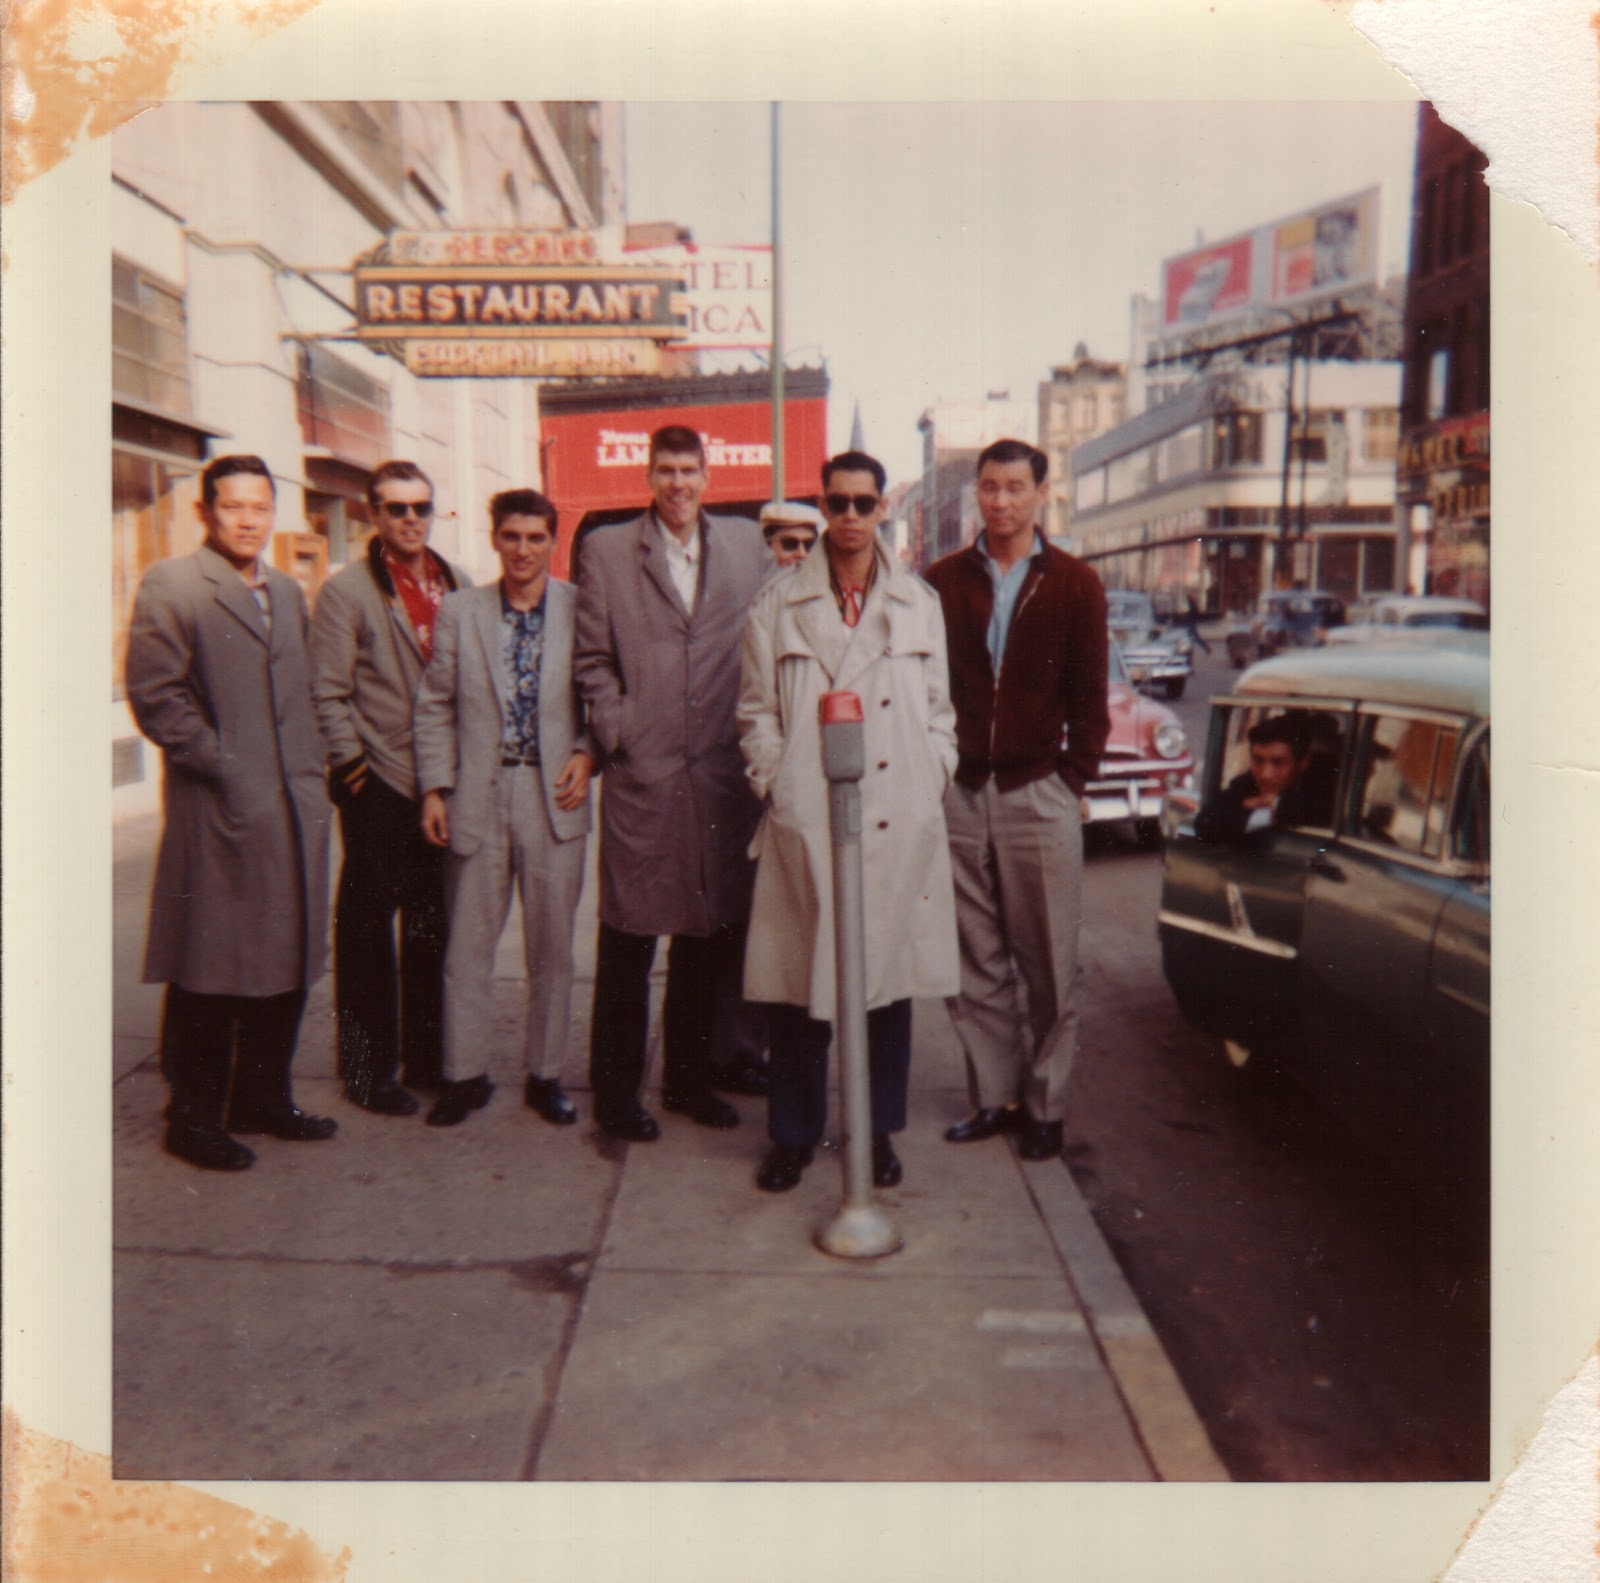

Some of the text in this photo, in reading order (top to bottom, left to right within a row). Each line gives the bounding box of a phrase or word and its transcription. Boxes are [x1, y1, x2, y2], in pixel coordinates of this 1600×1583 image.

[449, 234, 597, 258] PERSHING
[655, 261, 769, 291] TEL
[366, 284, 660, 321] RESTAURANT
[688, 304, 766, 333] ICA
[416, 343, 555, 367] COCKTAIL
[596, 445, 773, 466] LAMHTER
